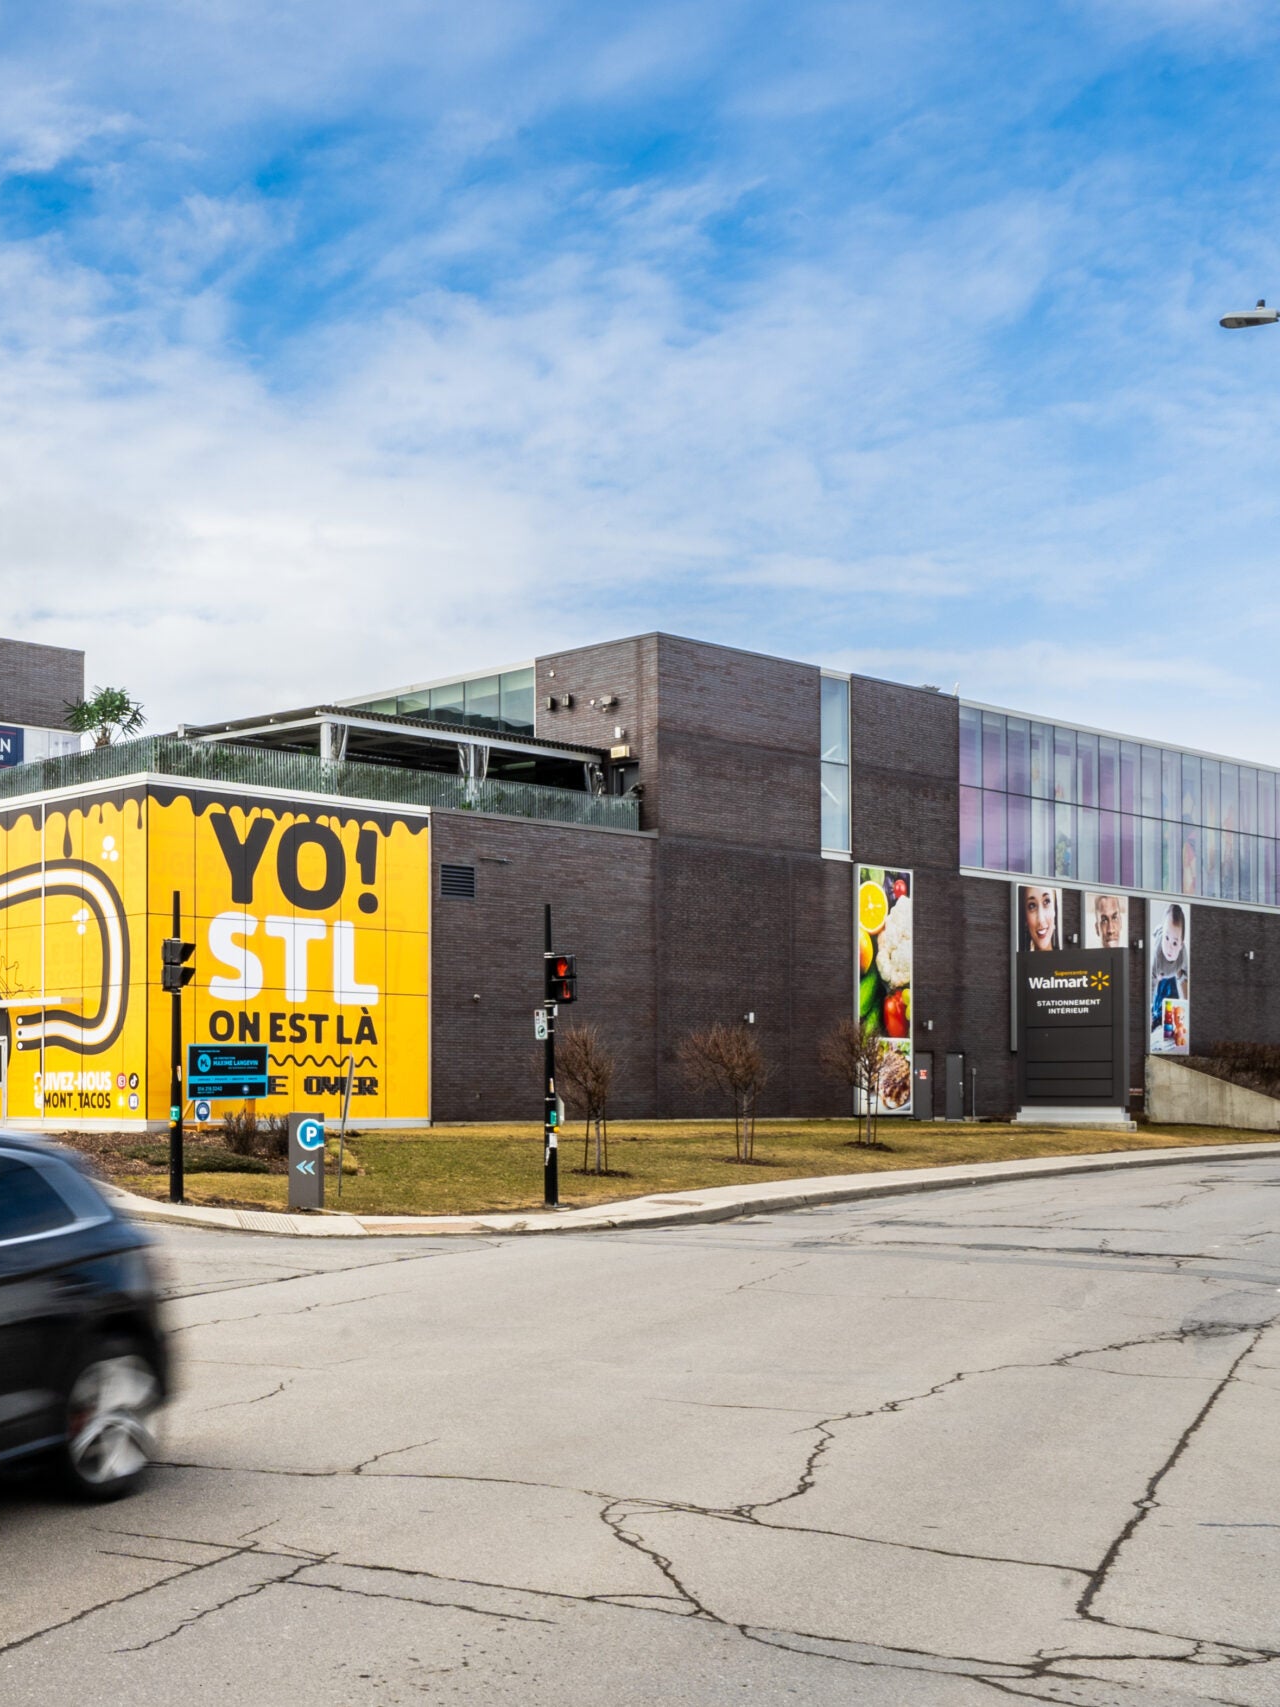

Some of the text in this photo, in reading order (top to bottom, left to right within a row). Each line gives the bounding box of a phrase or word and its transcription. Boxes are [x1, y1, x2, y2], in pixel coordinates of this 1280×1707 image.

[209, 812, 379, 915] YO!
[208, 911, 379, 1005] STL
[1028, 975, 1088, 989] Walmart
[1036, 999, 1101, 1007] STATIONNEMENT
[1048, 1006, 1089, 1014] INTÉRIEUR
[209, 1007, 378, 1045] ON EST LÀ
[306, 1126, 318, 1143] P
